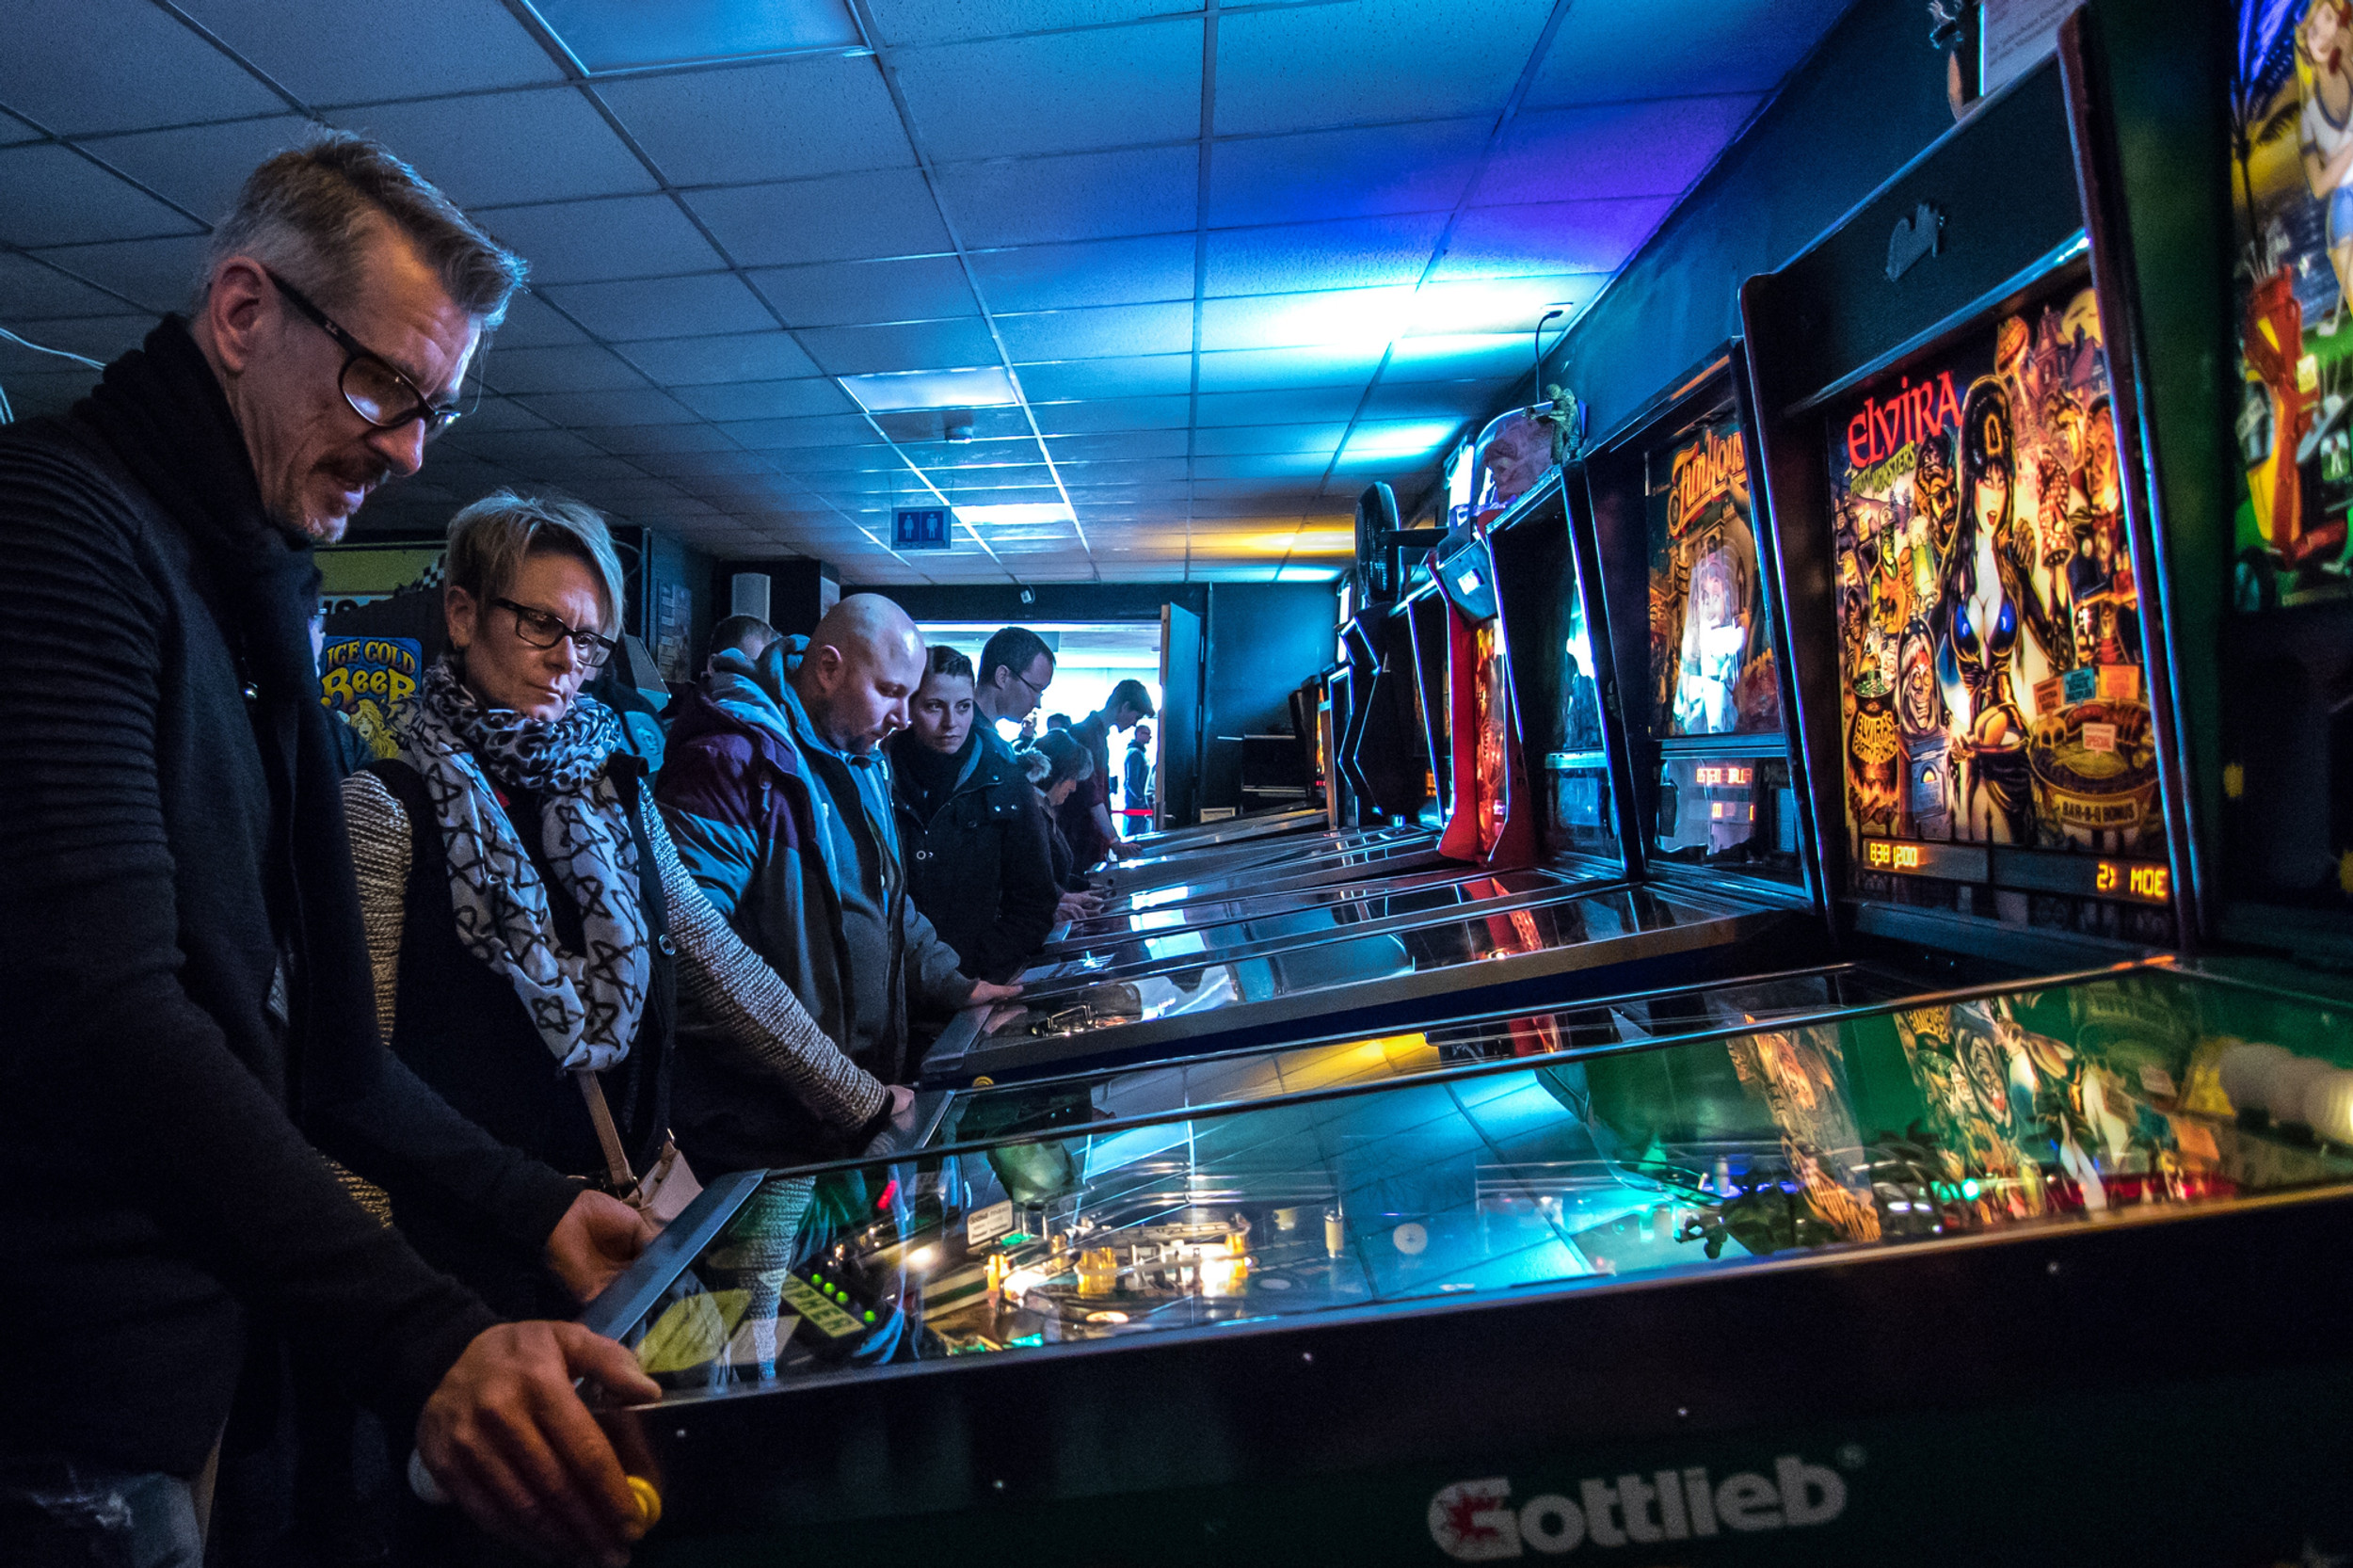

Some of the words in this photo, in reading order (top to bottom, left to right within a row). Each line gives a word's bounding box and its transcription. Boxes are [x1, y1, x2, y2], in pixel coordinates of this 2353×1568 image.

[1849, 371, 1962, 468] ELVIRA
[327, 641, 360, 670] ICE
[365, 641, 416, 675] COLD
[1427, 1455, 1847, 1561] Gottlieb
